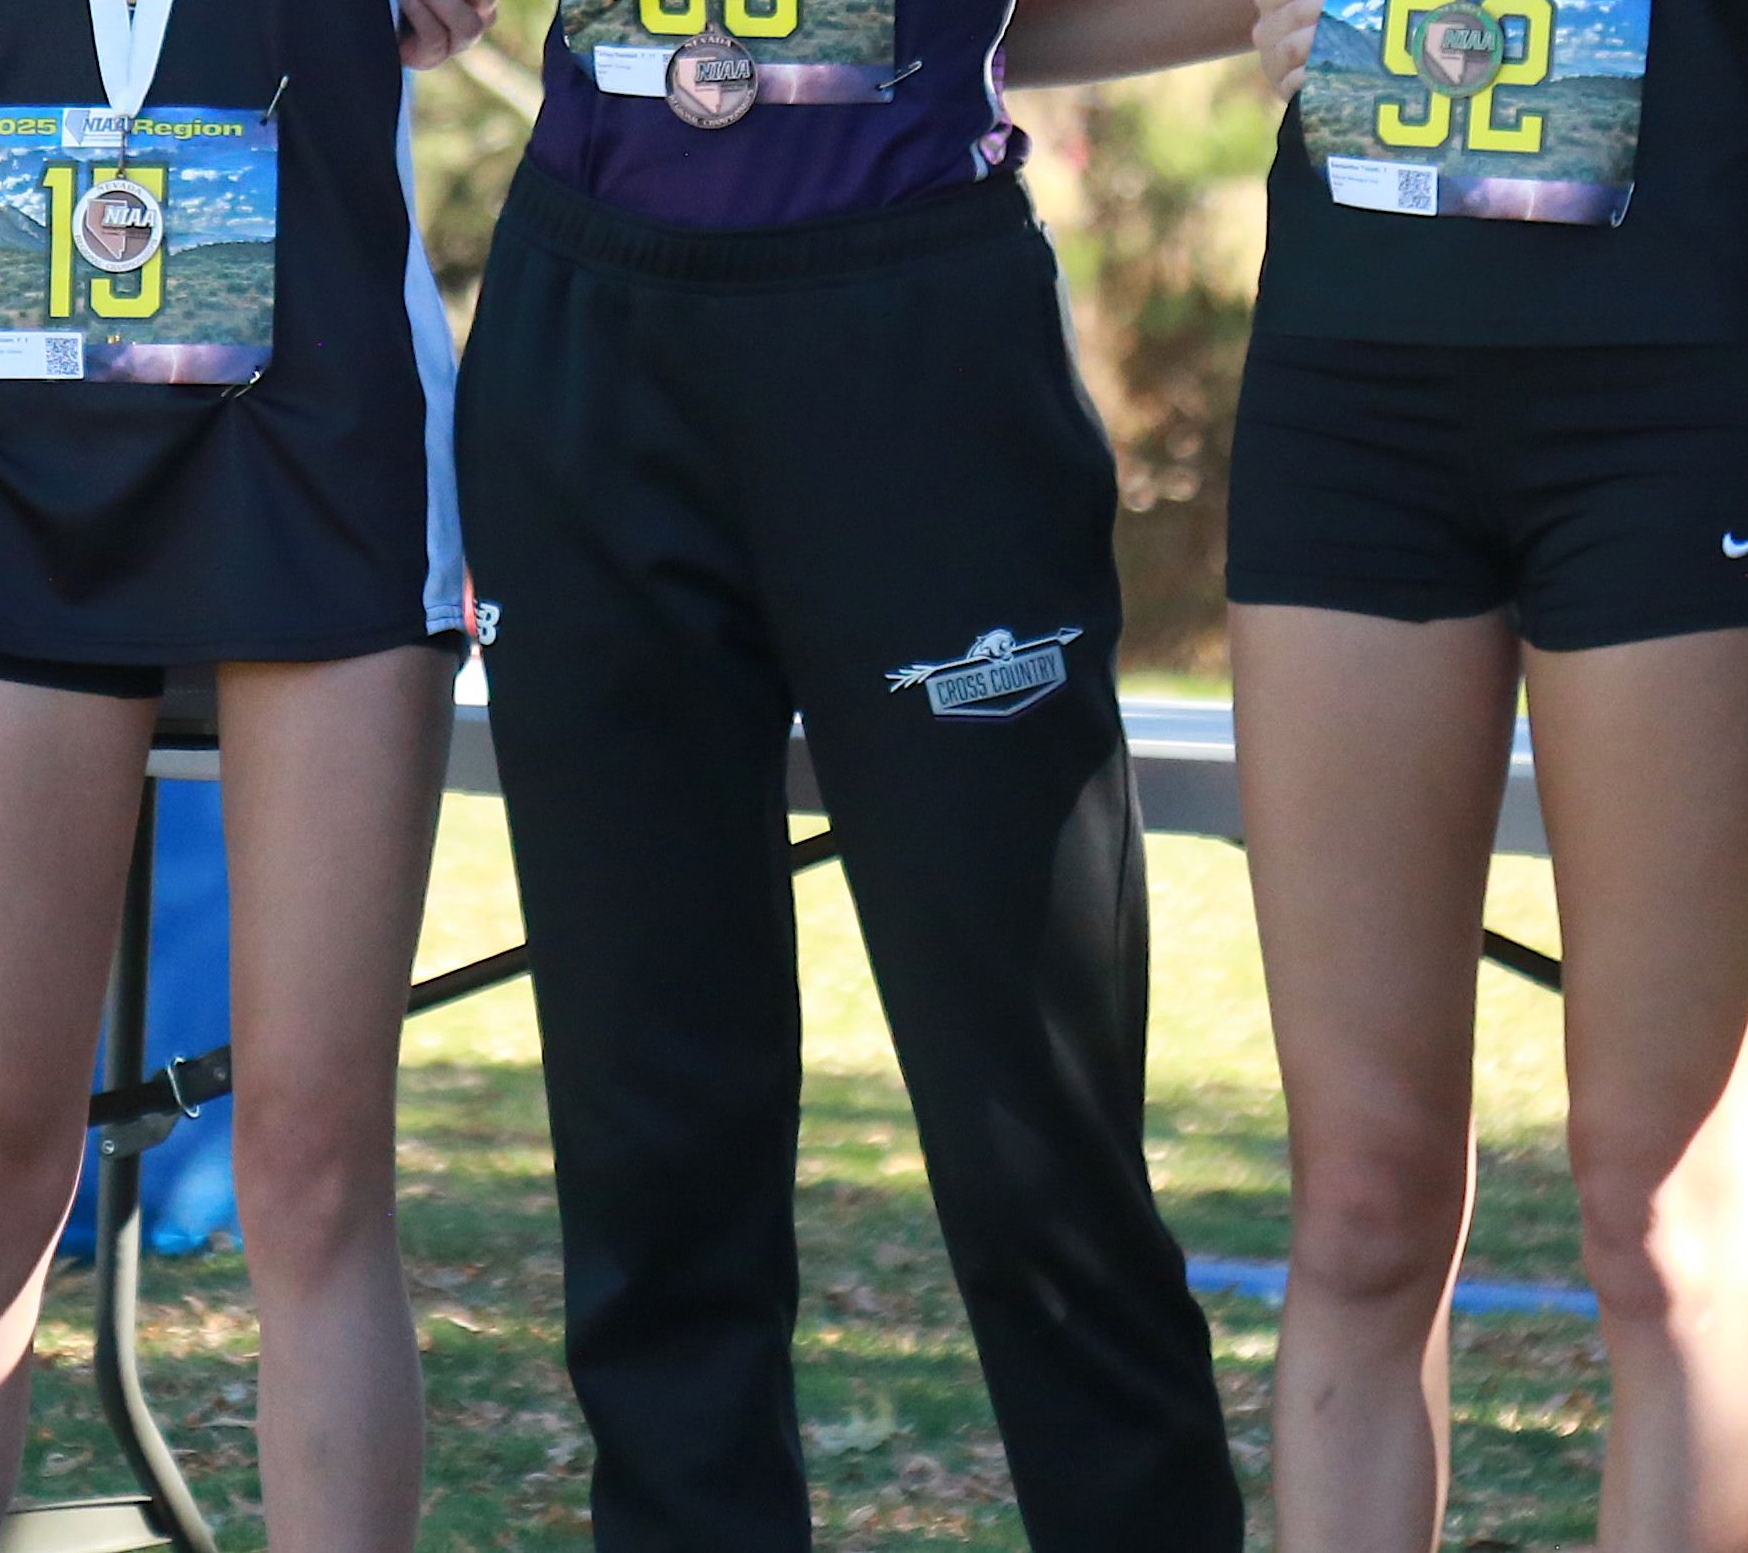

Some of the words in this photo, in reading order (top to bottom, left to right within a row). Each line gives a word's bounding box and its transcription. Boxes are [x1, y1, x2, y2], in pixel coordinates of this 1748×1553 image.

[694, 59, 751, 83] NIAA
[131, 119, 244, 140] Region
[101, 205, 158, 228] NIAA
[936, 672, 988, 706] CROSS
[990, 654, 1059, 694] COUNTRY
